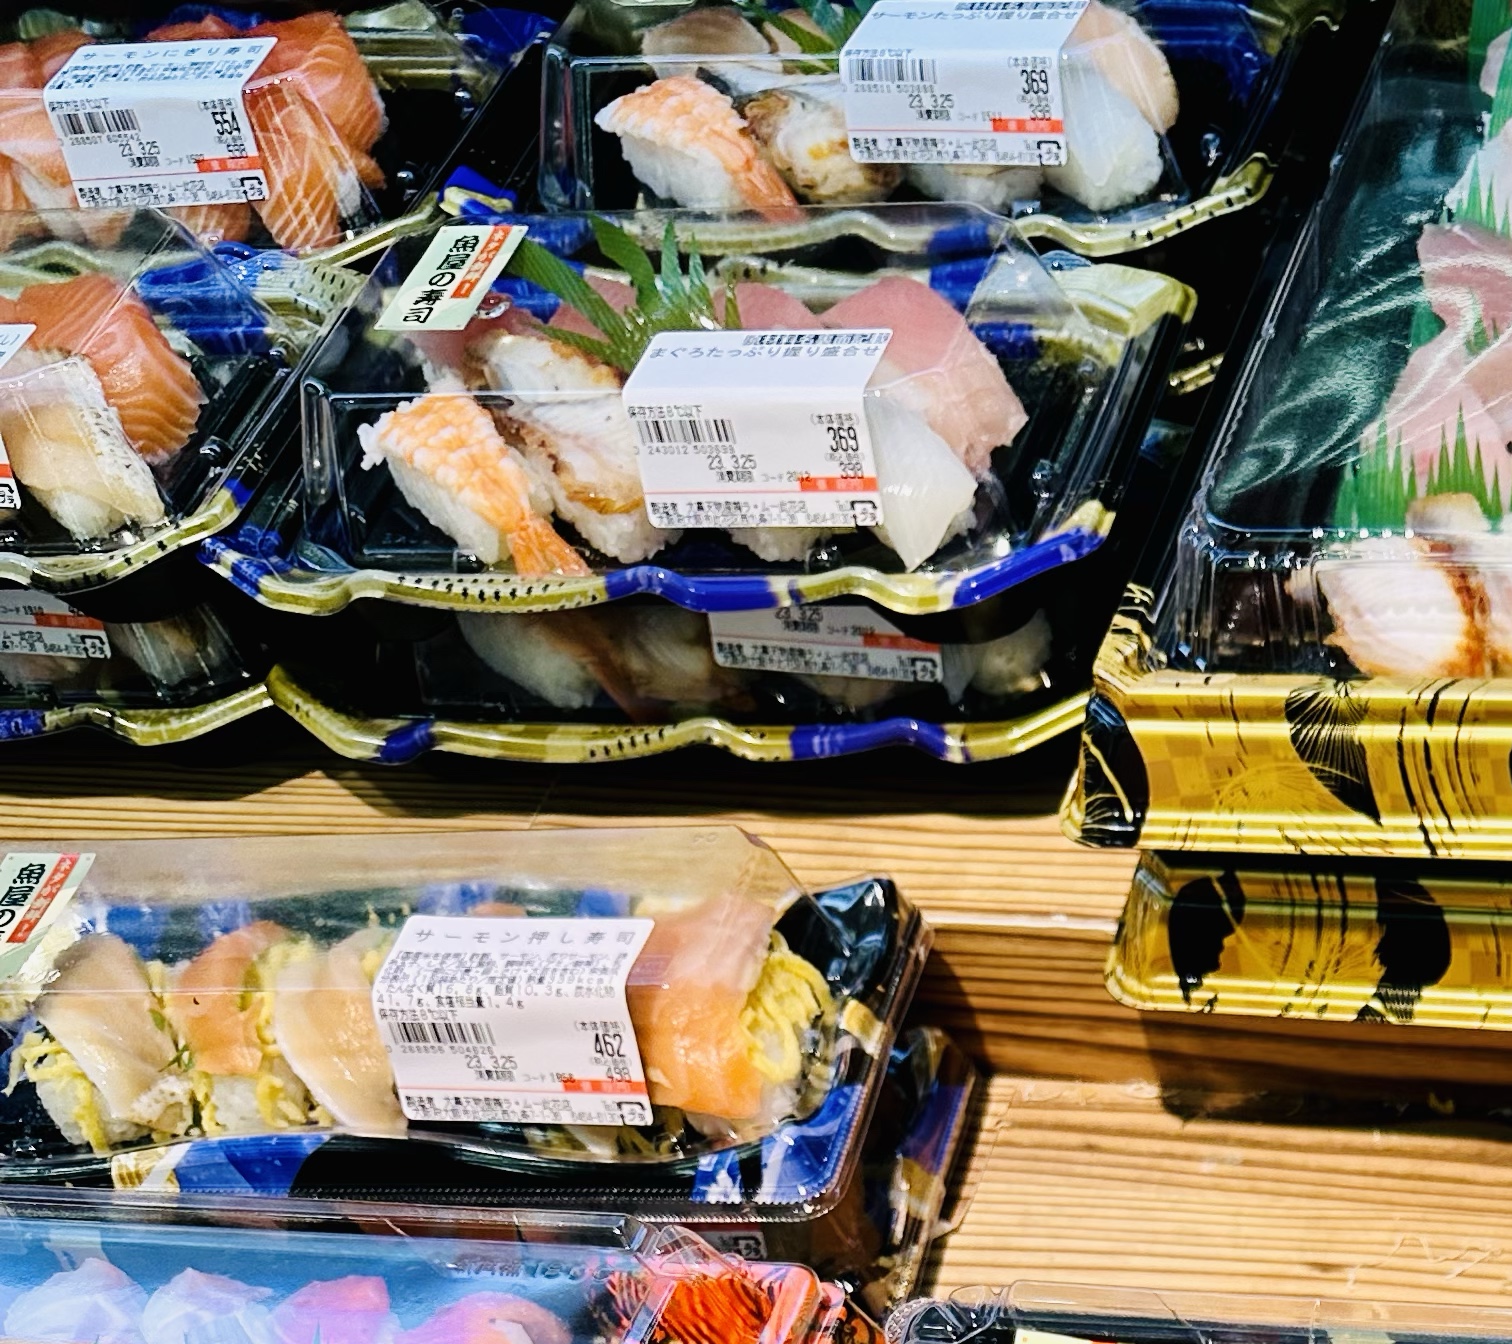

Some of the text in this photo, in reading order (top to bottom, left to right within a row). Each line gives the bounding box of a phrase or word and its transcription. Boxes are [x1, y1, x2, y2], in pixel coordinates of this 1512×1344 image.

[1021, 70, 1049, 95] 369
[211, 111, 241, 135] 554
[403, 235, 479, 323] 魚屋の寿司
[649, 346, 880, 358] まぐろたっぷり握り盛合せ
[827, 427, 858, 452] 369
[416, 929, 636, 945] サーモン押し寿司
[595, 1033, 625, 1058] 462
